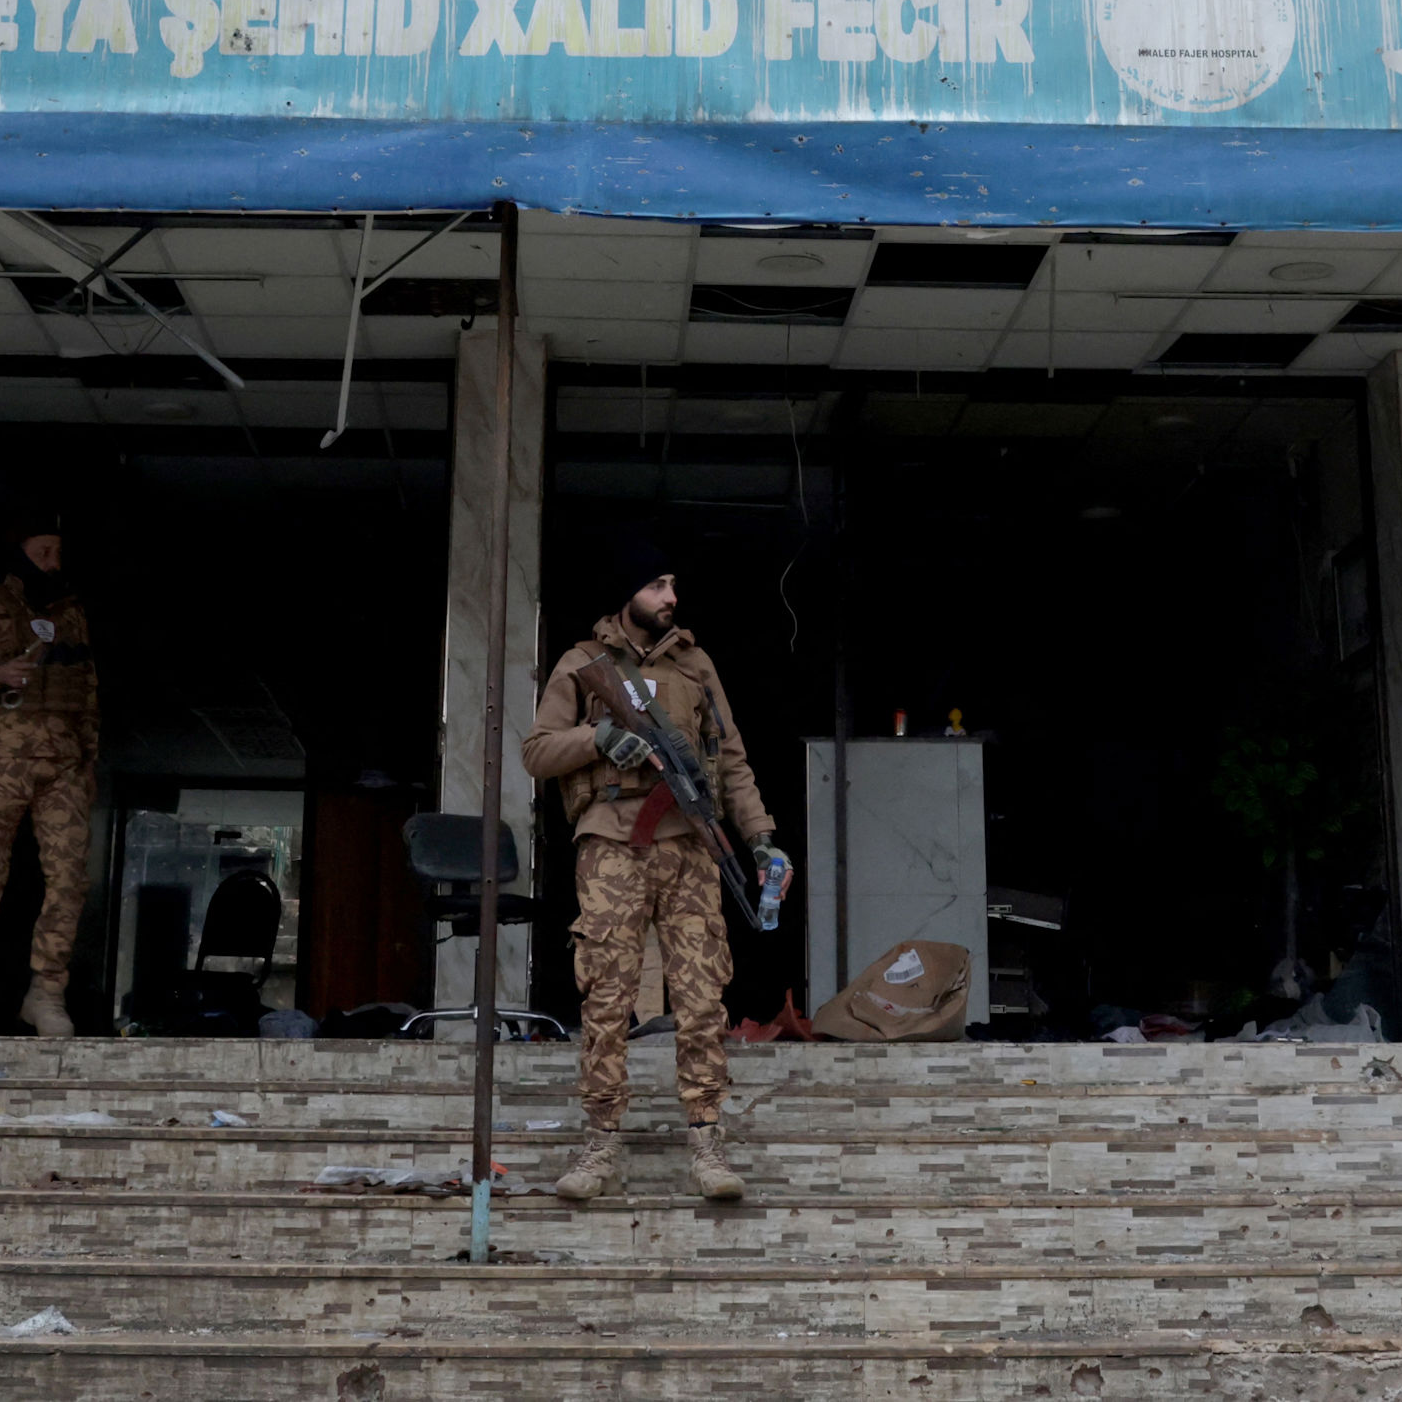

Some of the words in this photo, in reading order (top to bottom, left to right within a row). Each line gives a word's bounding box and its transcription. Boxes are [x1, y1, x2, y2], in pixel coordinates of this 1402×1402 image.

[1138, 48, 1176, 58] KHALED
[1179, 49, 1208, 58] FAJER
[1211, 49, 1258, 58] HOSPITAL
